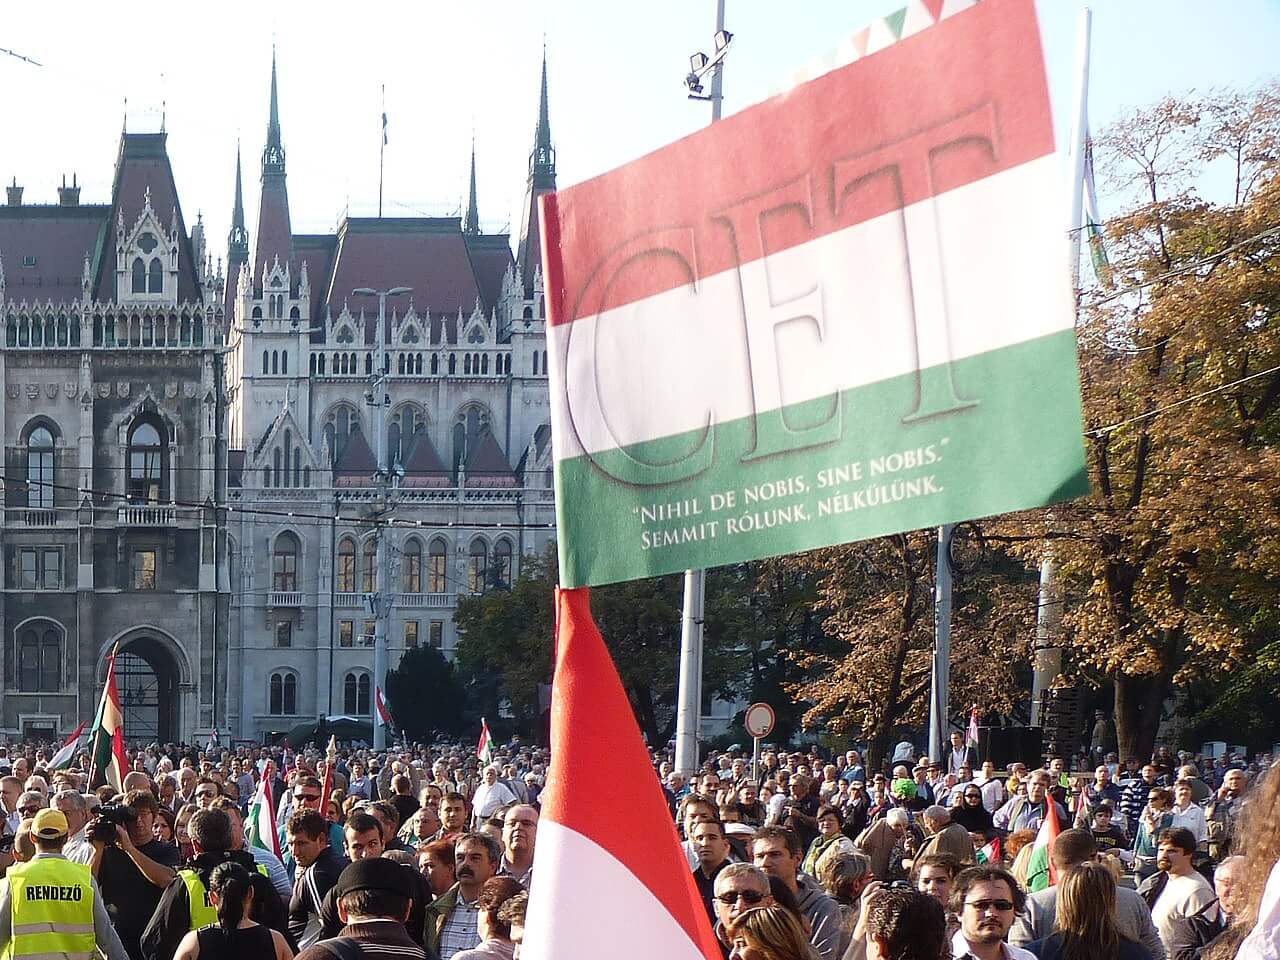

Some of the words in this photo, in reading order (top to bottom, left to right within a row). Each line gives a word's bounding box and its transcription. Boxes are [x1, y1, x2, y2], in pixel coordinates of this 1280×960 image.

[565, 99, 1003, 486] CET
[641, 521, 719, 550] SEMMIT
[726, 503, 811, 535] RÓLUNK,
[817, 474, 944, 517] NÉLKÜLÜNK.
[711, 490, 736, 512] DE
[745, 475, 811, 505] NOBIS,
[817, 461, 863, 489] SINE
[26, 884, 82, 902] RENDEZŐ
